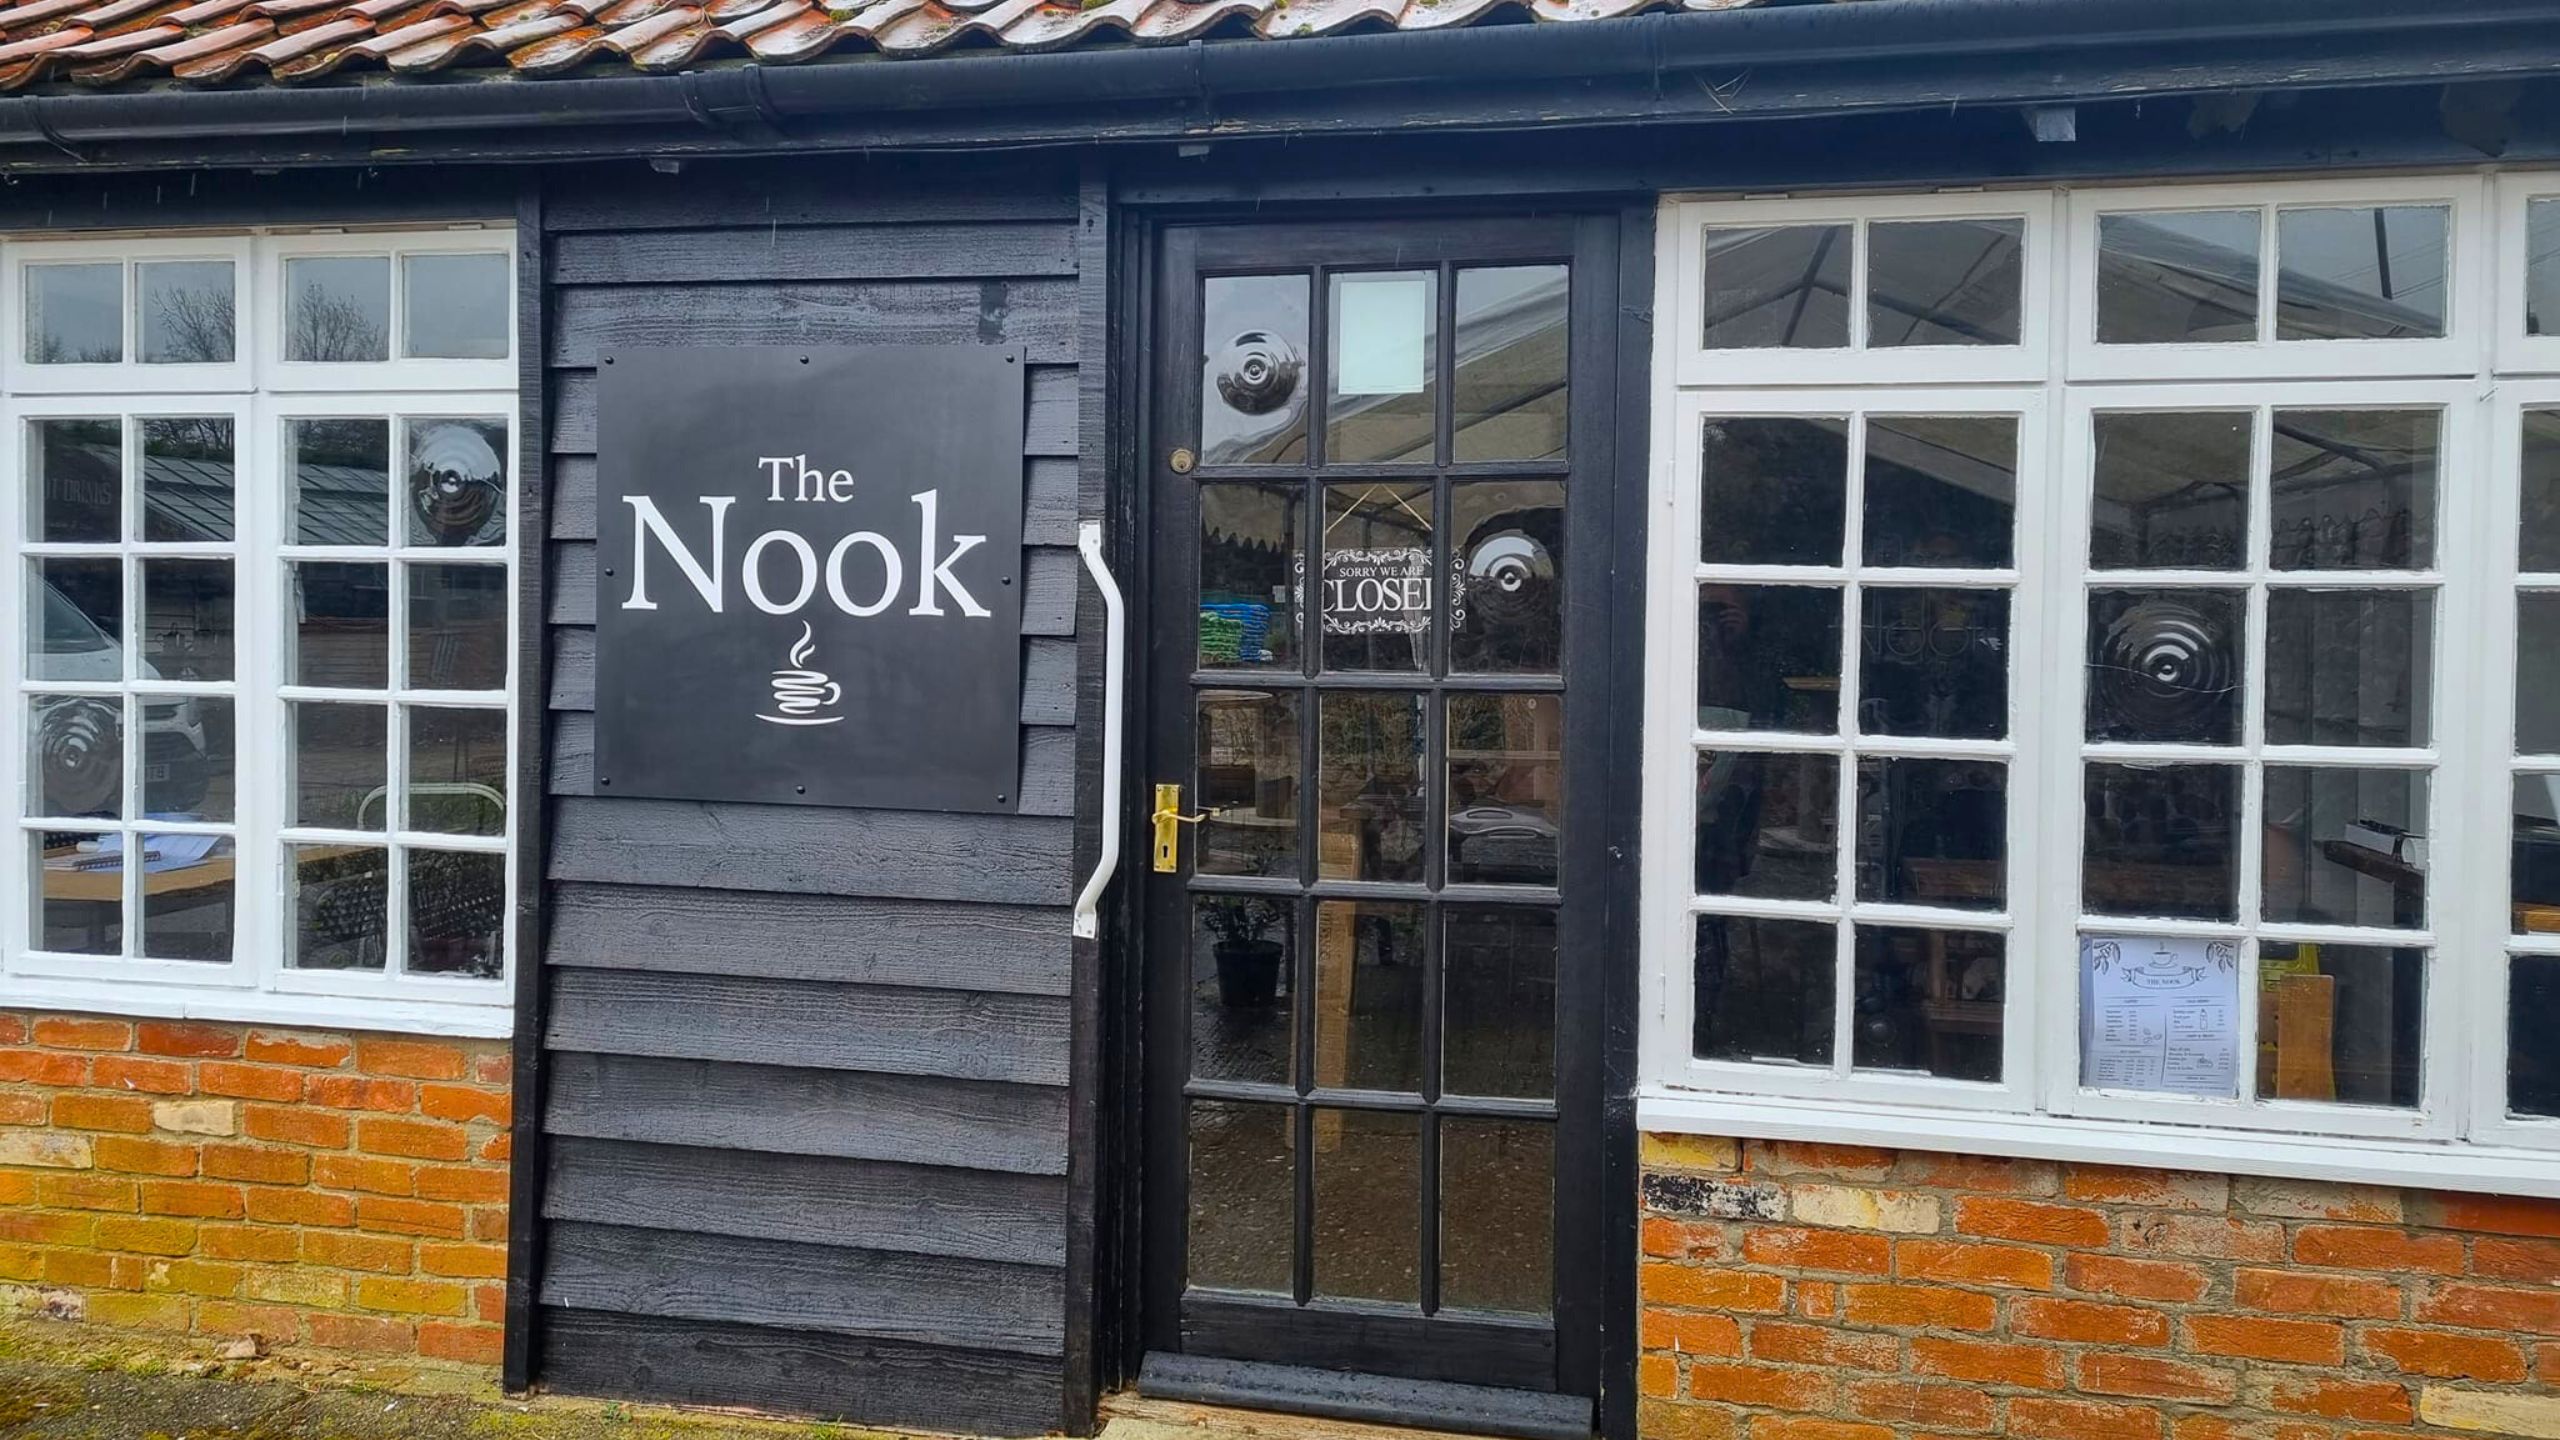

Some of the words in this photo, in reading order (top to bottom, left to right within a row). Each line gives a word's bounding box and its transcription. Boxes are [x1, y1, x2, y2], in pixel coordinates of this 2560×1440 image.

[758, 455, 854, 502] The
[622, 489, 991, 617] Nook
[1340, 567, 1376, 577] SORRY
[1380, 566, 1398, 577] WE
[1400, 566, 1424, 576] ARE
